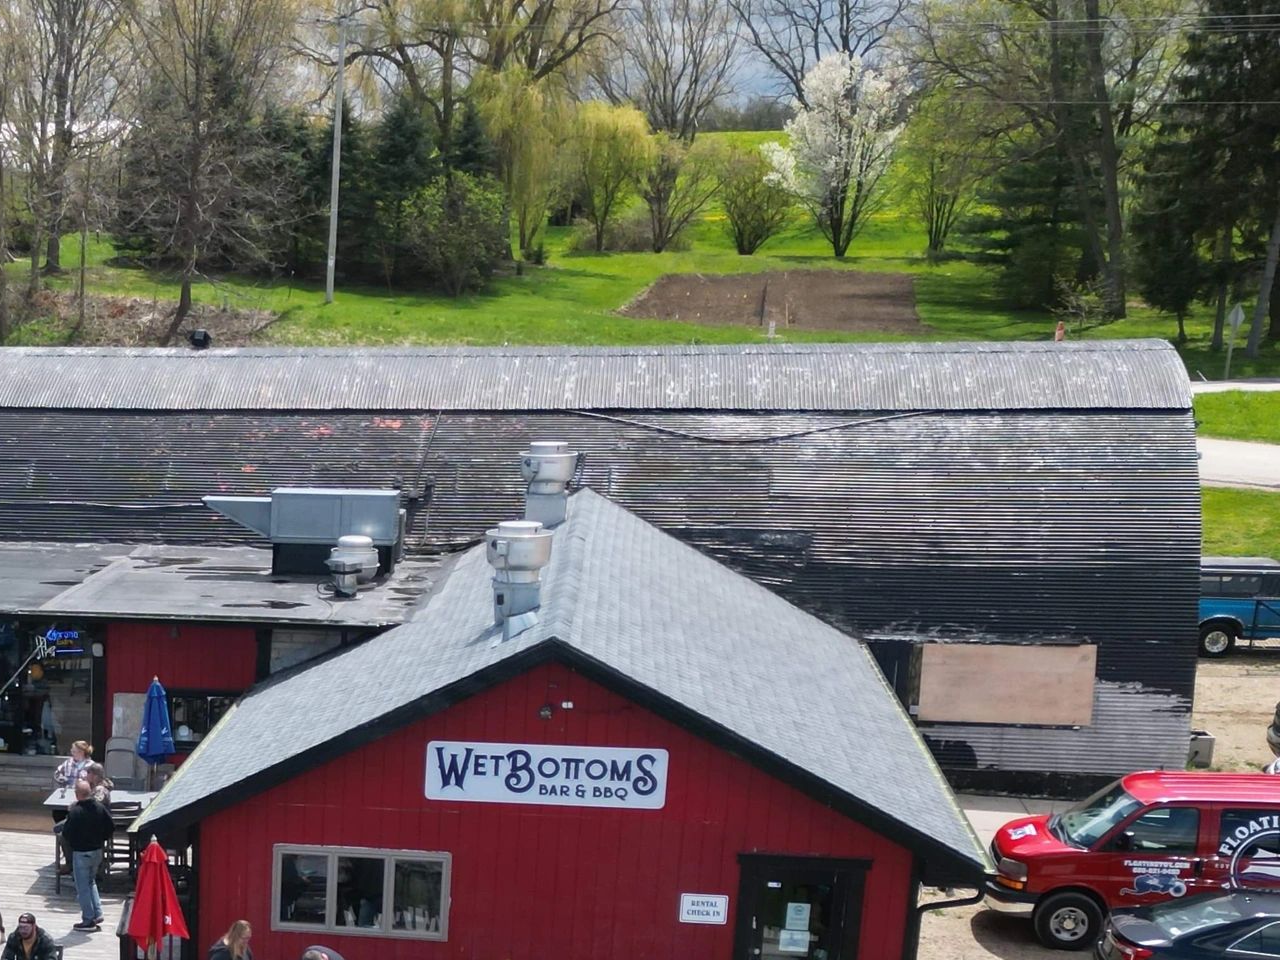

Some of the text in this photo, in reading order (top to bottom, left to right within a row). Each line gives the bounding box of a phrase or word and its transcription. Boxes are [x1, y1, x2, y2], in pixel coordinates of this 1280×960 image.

[539, 784, 629, 801] BAR & BBQ
[691, 900, 718, 908] RENTAL
[686, 909, 711, 917] CHECK
